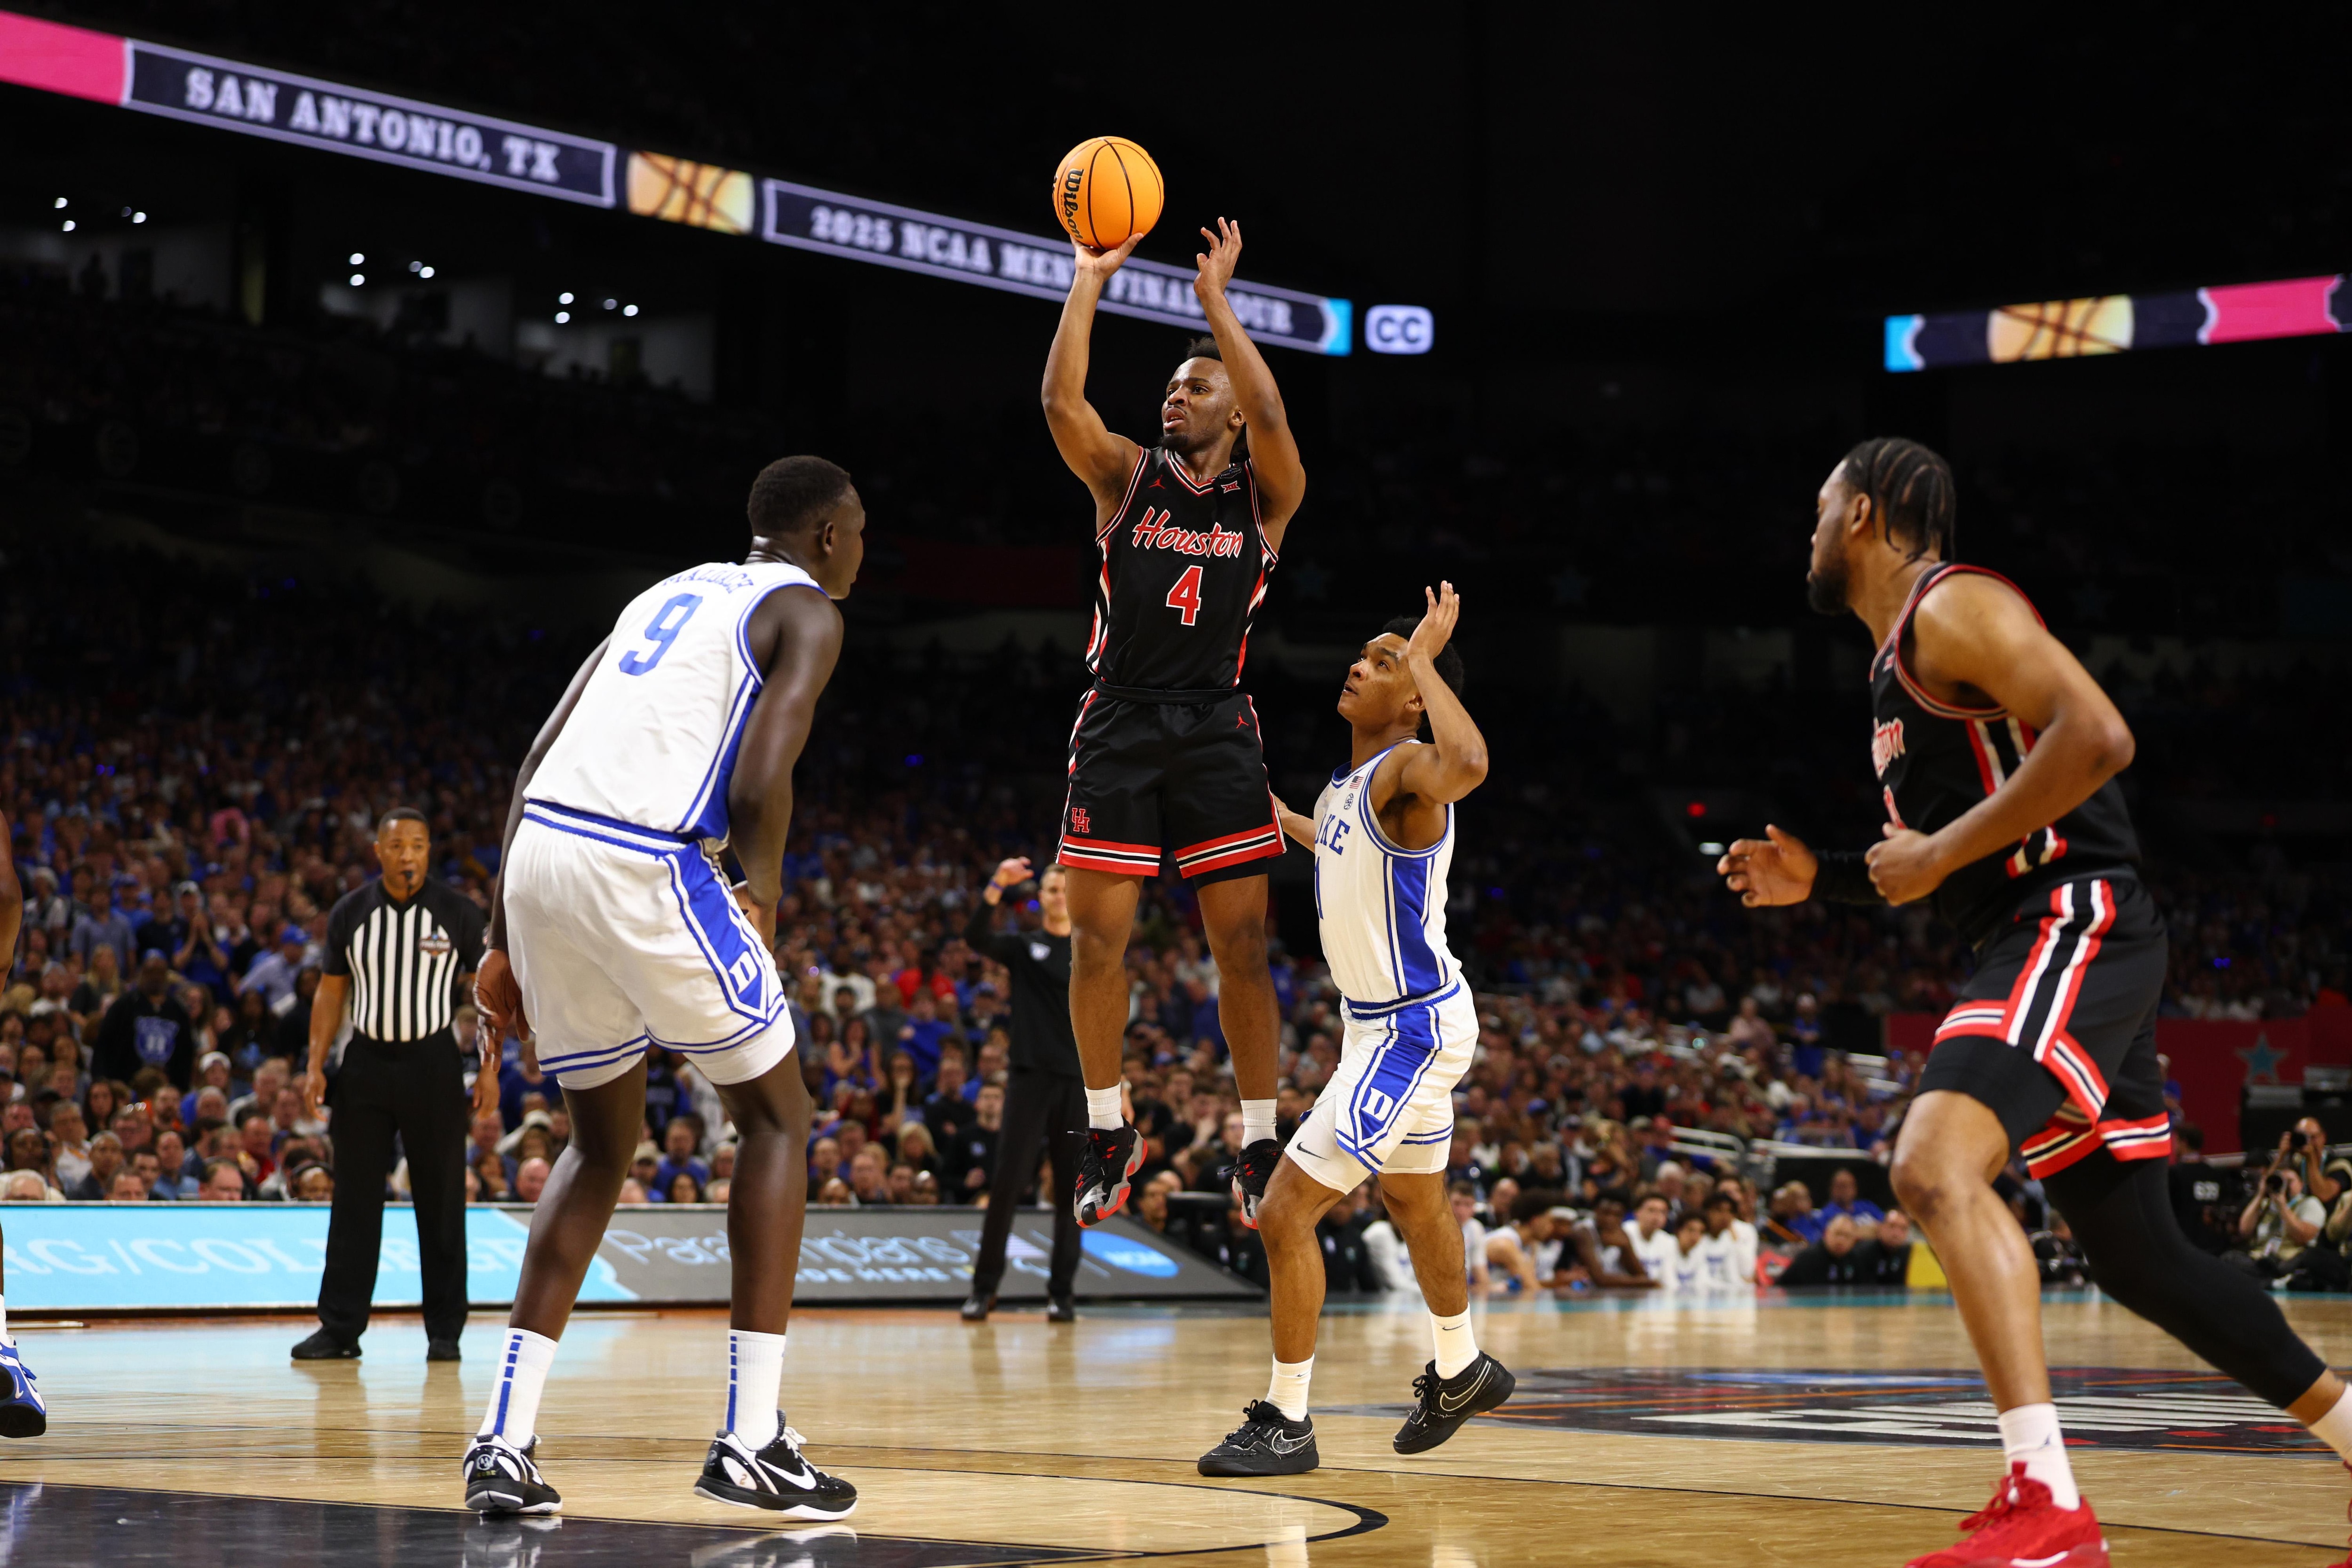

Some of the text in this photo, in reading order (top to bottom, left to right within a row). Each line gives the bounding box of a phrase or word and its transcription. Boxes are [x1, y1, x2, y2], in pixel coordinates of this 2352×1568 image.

[185, 66, 560, 183] SAN ANTONIO, TX
[1064, 167, 1084, 239] Wilson
[810, 205, 893, 253] 2025
[899, 222, 993, 273] NCAA
[999, 242, 1074, 289] MEN
[1376, 315, 1422, 344] CC
[1132, 506, 1243, 558] Houston
[1166, 565, 1203, 626] 4
[619, 593, 703, 676] 9
[729, 950, 758, 995] D
[1361, 1086, 1394, 1122] D
